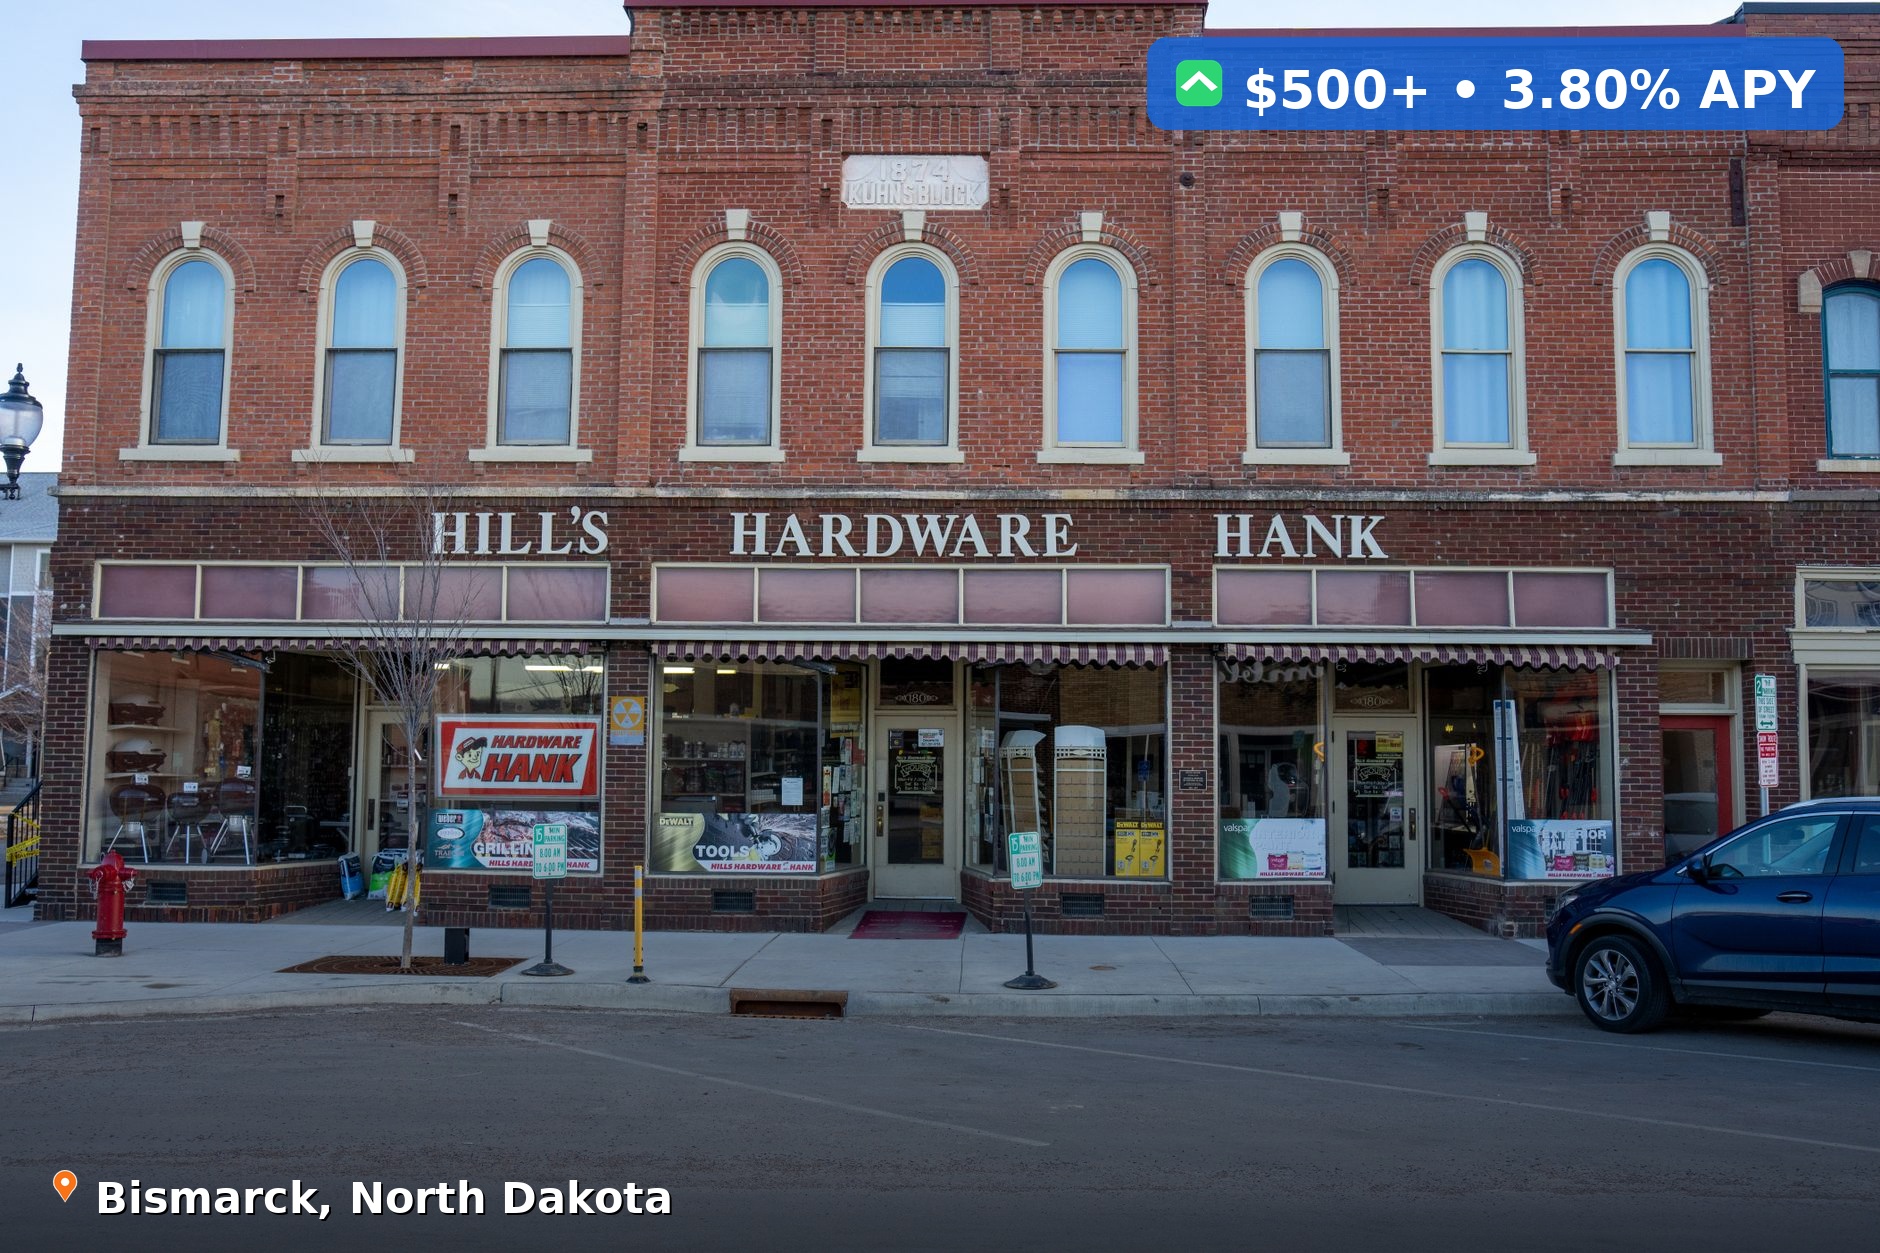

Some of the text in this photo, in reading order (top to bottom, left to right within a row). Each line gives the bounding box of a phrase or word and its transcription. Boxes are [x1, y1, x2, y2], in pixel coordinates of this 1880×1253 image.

[880, 158, 950, 182] 1874
[431, 506, 1389, 560] HILL'S HARDWARE HANK
[1756, 679, 1762, 694] 2
[491, 735, 583, 749] HARDWARE
[481, 753, 583, 783] HANK
[437, 814, 457, 823] weber
[473, 842, 533, 856] GRILLIN
[553, 847, 561, 857] AM
[695, 845, 750, 858] TOOLS
[511, 860, 533, 868] HARD
[567, 861, 590, 869] HANK
[557, 861, 565, 871] PM
[734, 863, 782, 871] HARDWARE
[789, 863, 814, 871] HANK
